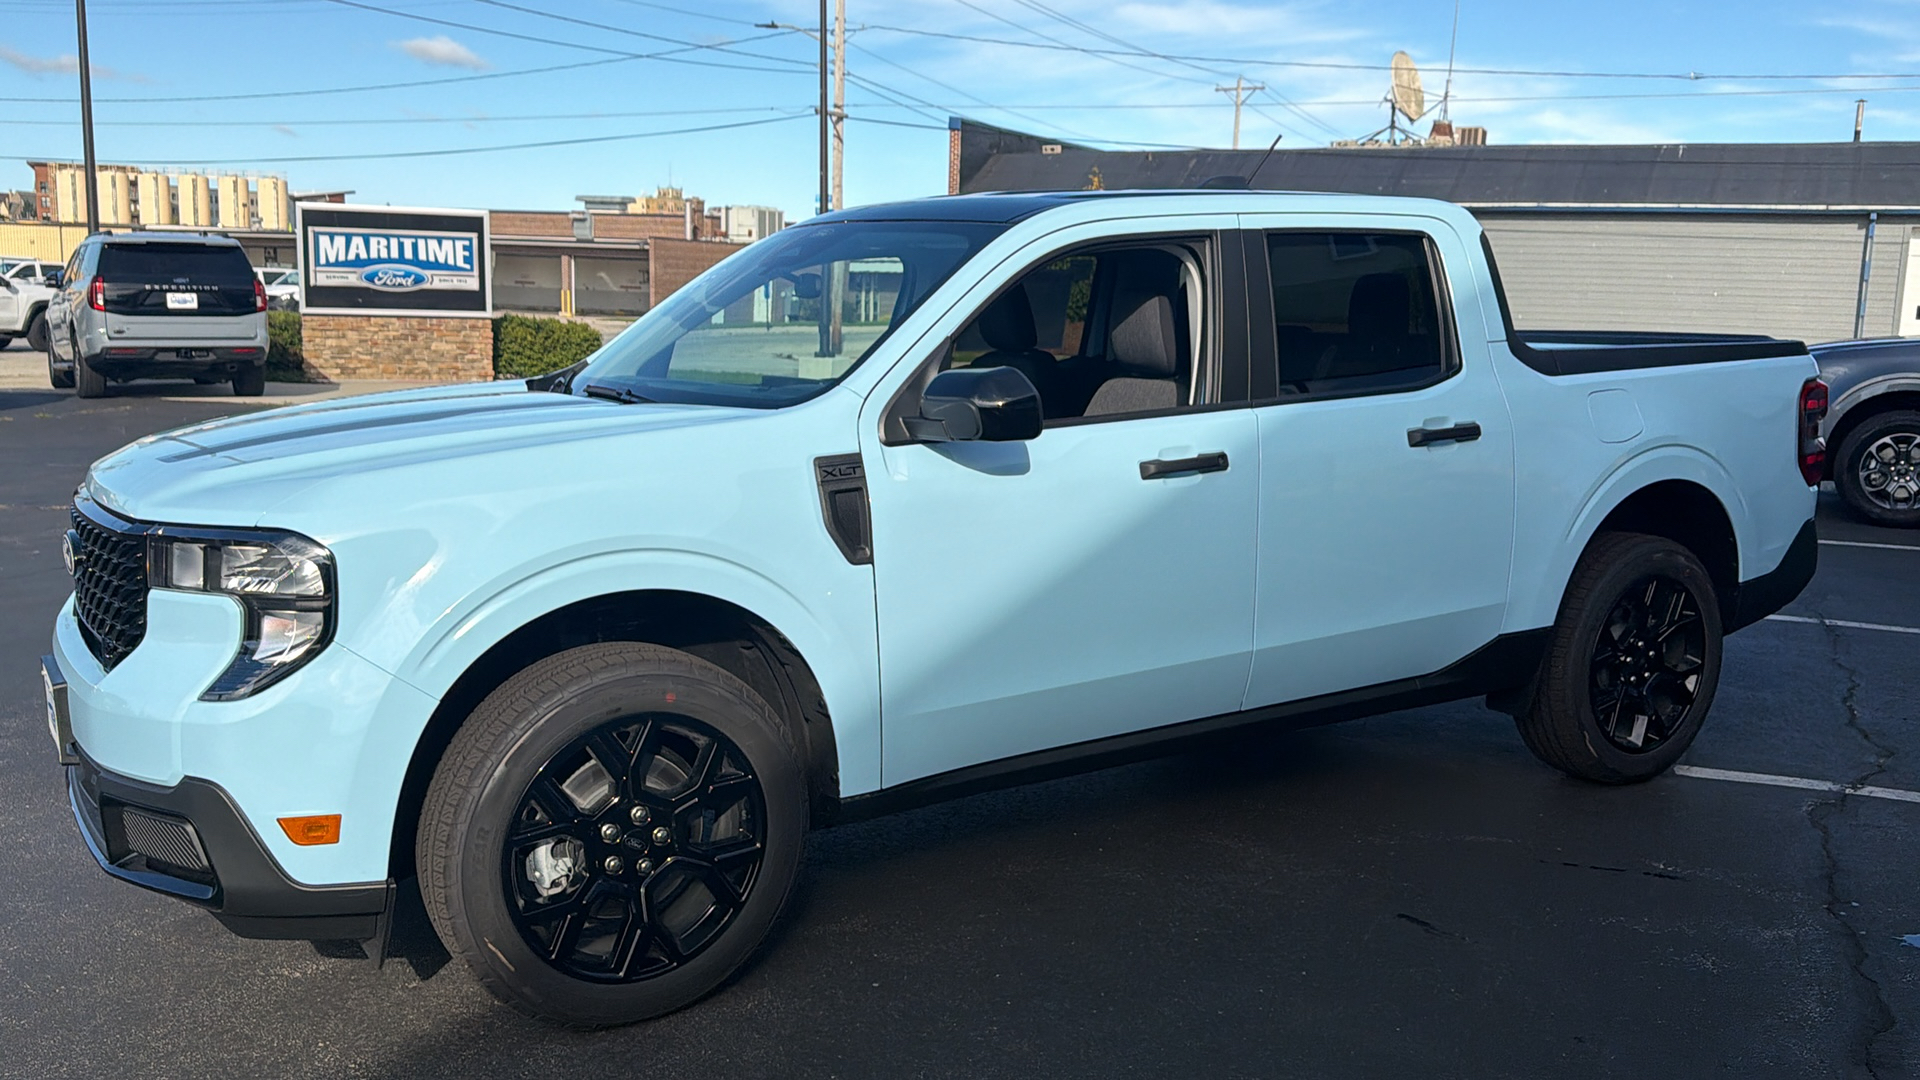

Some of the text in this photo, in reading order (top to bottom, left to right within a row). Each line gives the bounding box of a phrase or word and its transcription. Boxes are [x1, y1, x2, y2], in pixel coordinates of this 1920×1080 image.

[318, 234, 471, 270] MARITIME
[373, 269, 415, 287] Ford
[821, 466, 862, 479] XLT
